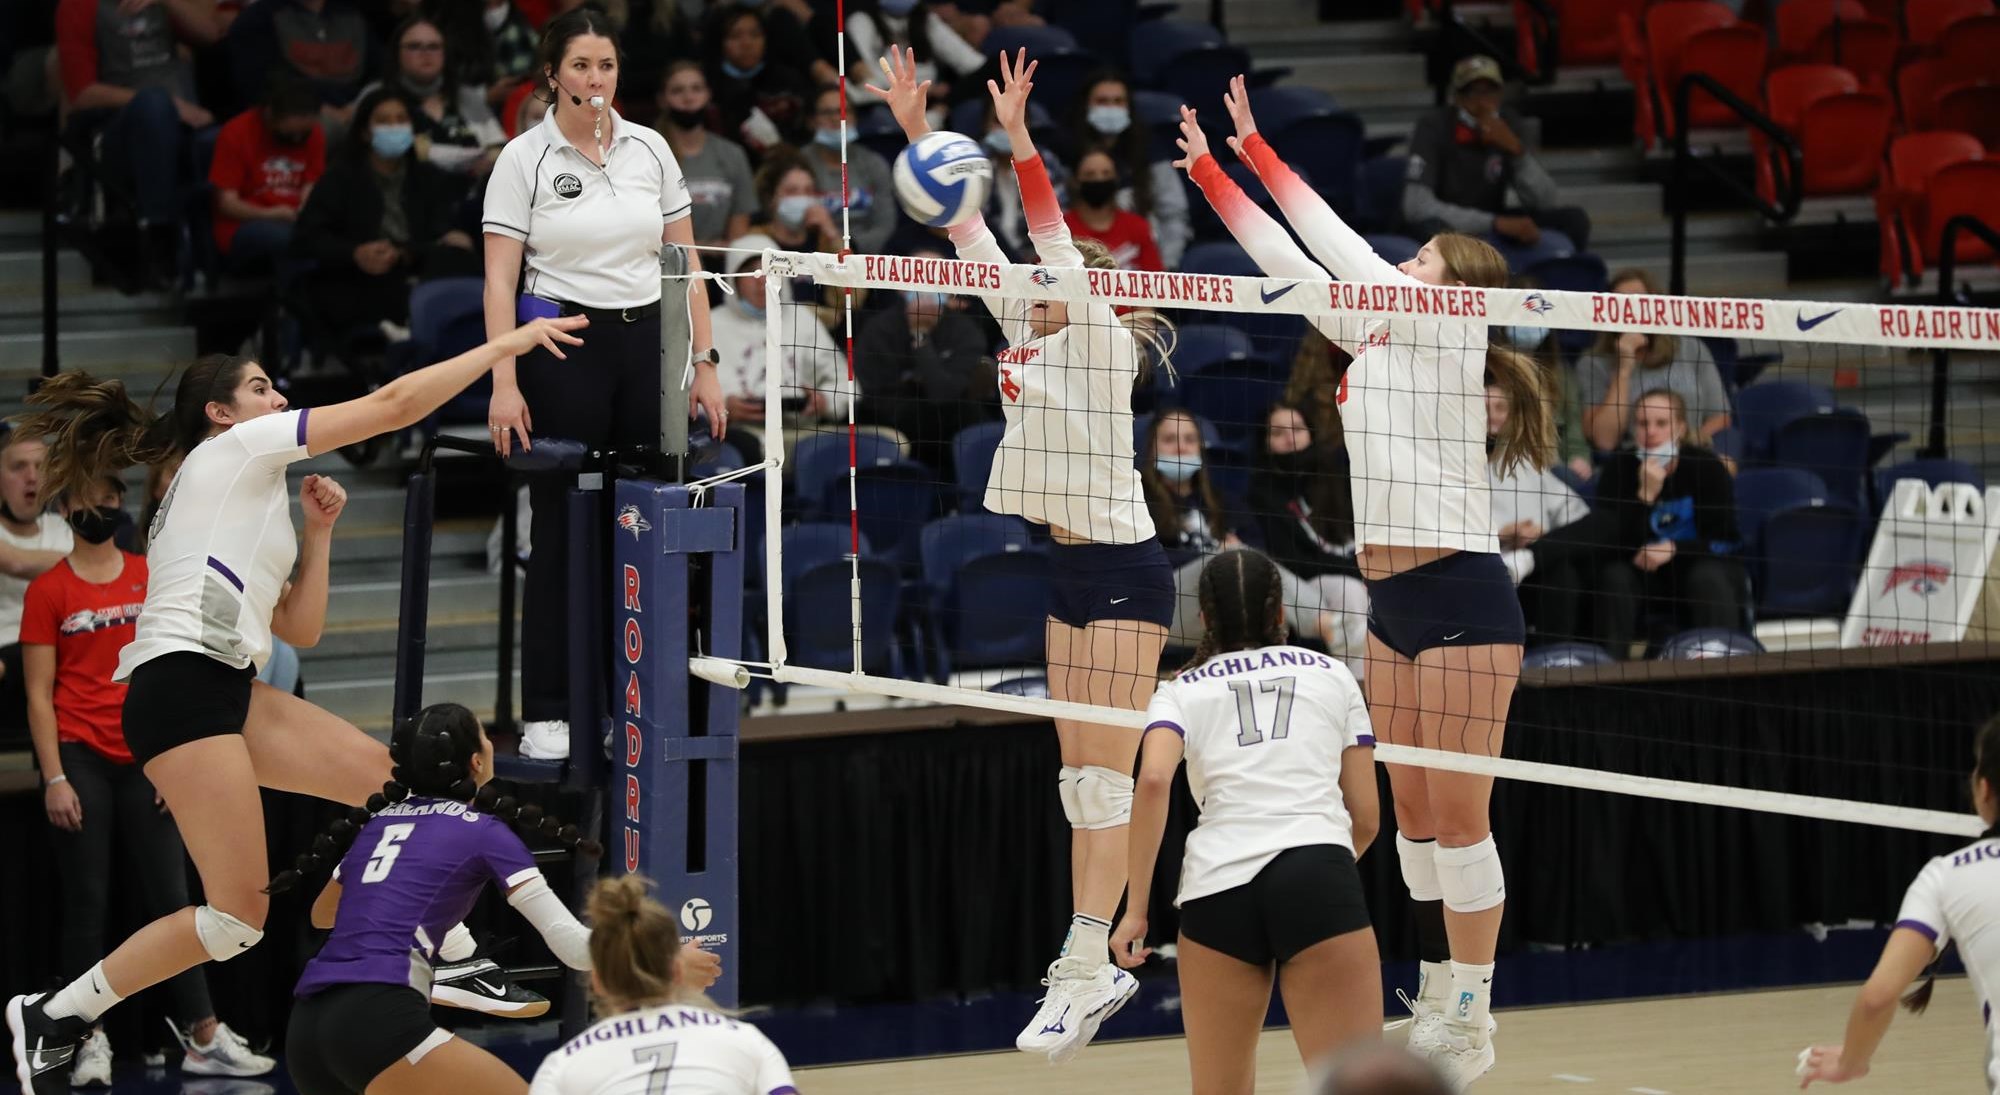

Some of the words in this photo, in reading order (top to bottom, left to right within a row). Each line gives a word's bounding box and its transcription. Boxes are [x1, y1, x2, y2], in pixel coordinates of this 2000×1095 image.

[865, 256, 1000, 289] ROADRUNNERS
[1088, 271, 1233, 303] ROADRUNNERS
[1329, 283, 1486, 317] ROADRUNNERS
[1592, 296, 1764, 330] ROADRUNNERS
[1880, 309, 2000, 340] ROADRUN
[1182, 651, 1331, 684] HIGHLANDS
[624, 564, 642, 873] ROADRU
[1227, 676, 1296, 747] 17
[361, 823, 416, 884] 5
[565, 1010, 738, 1056] HIGHLANDS
[632, 1041, 678, 1095] 7
